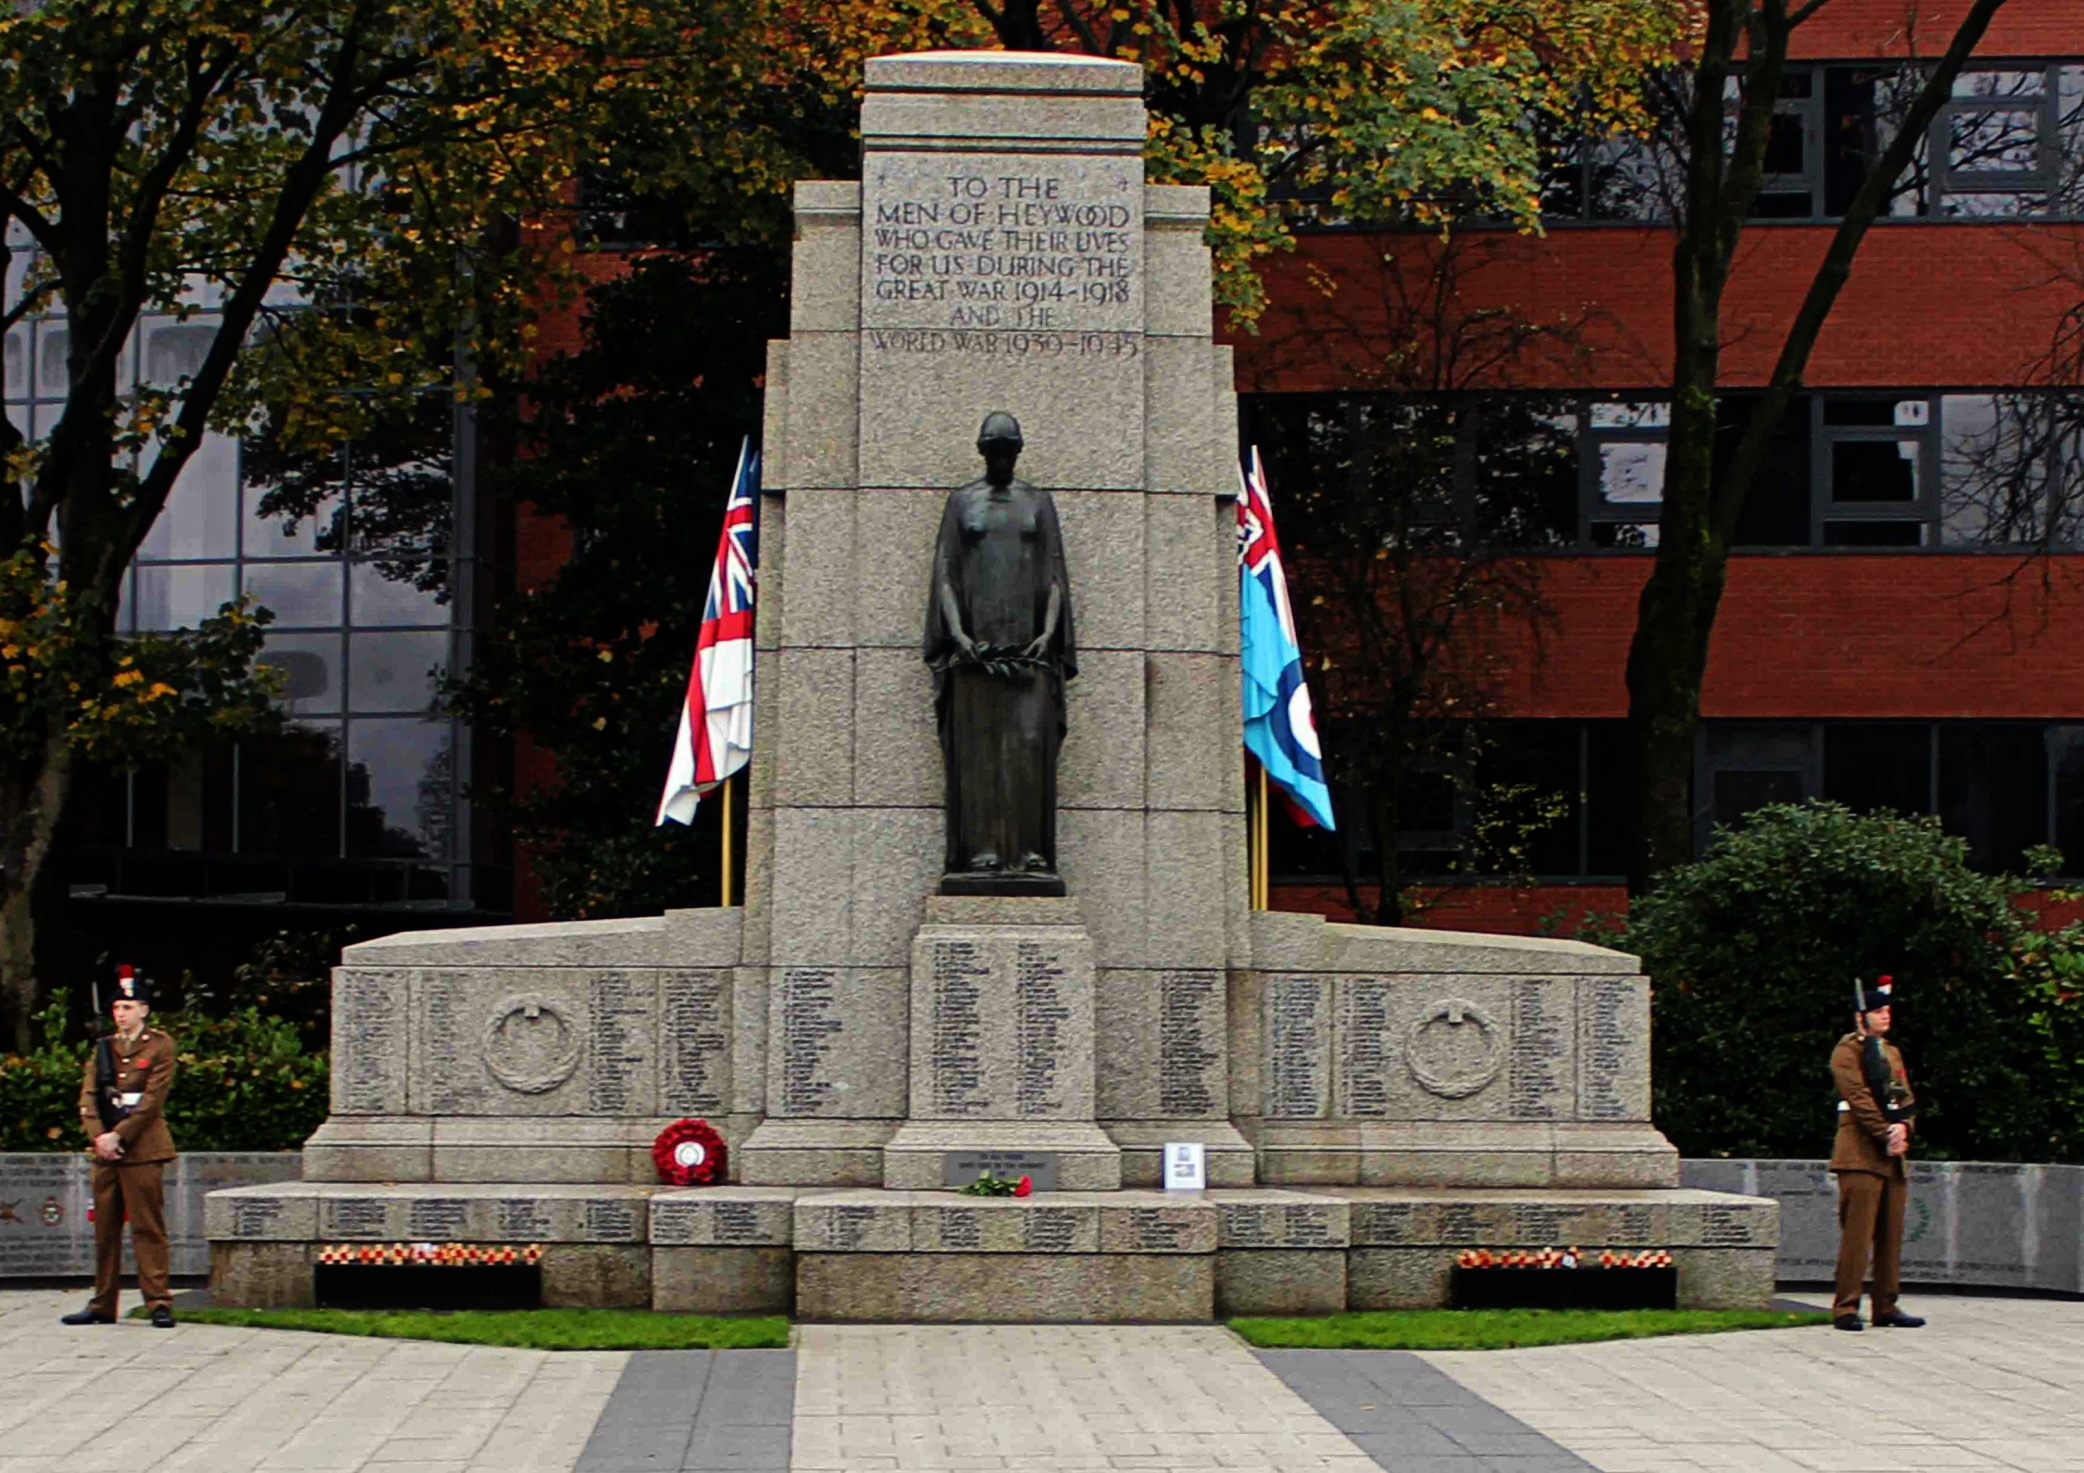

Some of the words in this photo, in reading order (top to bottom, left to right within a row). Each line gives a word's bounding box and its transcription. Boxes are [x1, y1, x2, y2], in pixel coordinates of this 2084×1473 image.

[949, 176, 988, 198] TO
[999, 177, 1059, 199] THE
[876, 202, 938, 225] MEN
[950, 203, 986, 225] OF
[999, 204, 1130, 228] HEYWOOD
[875, 229, 929, 249] WHO
[936, 230, 994, 251] GAVE
[1002, 231, 1068, 251] THEIR
[1076, 232, 1129, 253] LIVES
[876, 254, 922, 275] FOR
[932, 255, 965, 276] US
[977, 256, 1075, 277] DURING
[1084, 257, 1130, 278] THE
[876, 280, 948, 301] GREAT
[956, 282, 1006, 302] WAR
[1015, 281, 1131, 307] 1914-1918
[950, 307, 999, 328] AND
[1017, 307, 1054, 328] THE
[869, 332, 946, 352] WORLD
[952, 333, 999, 353] WAR
